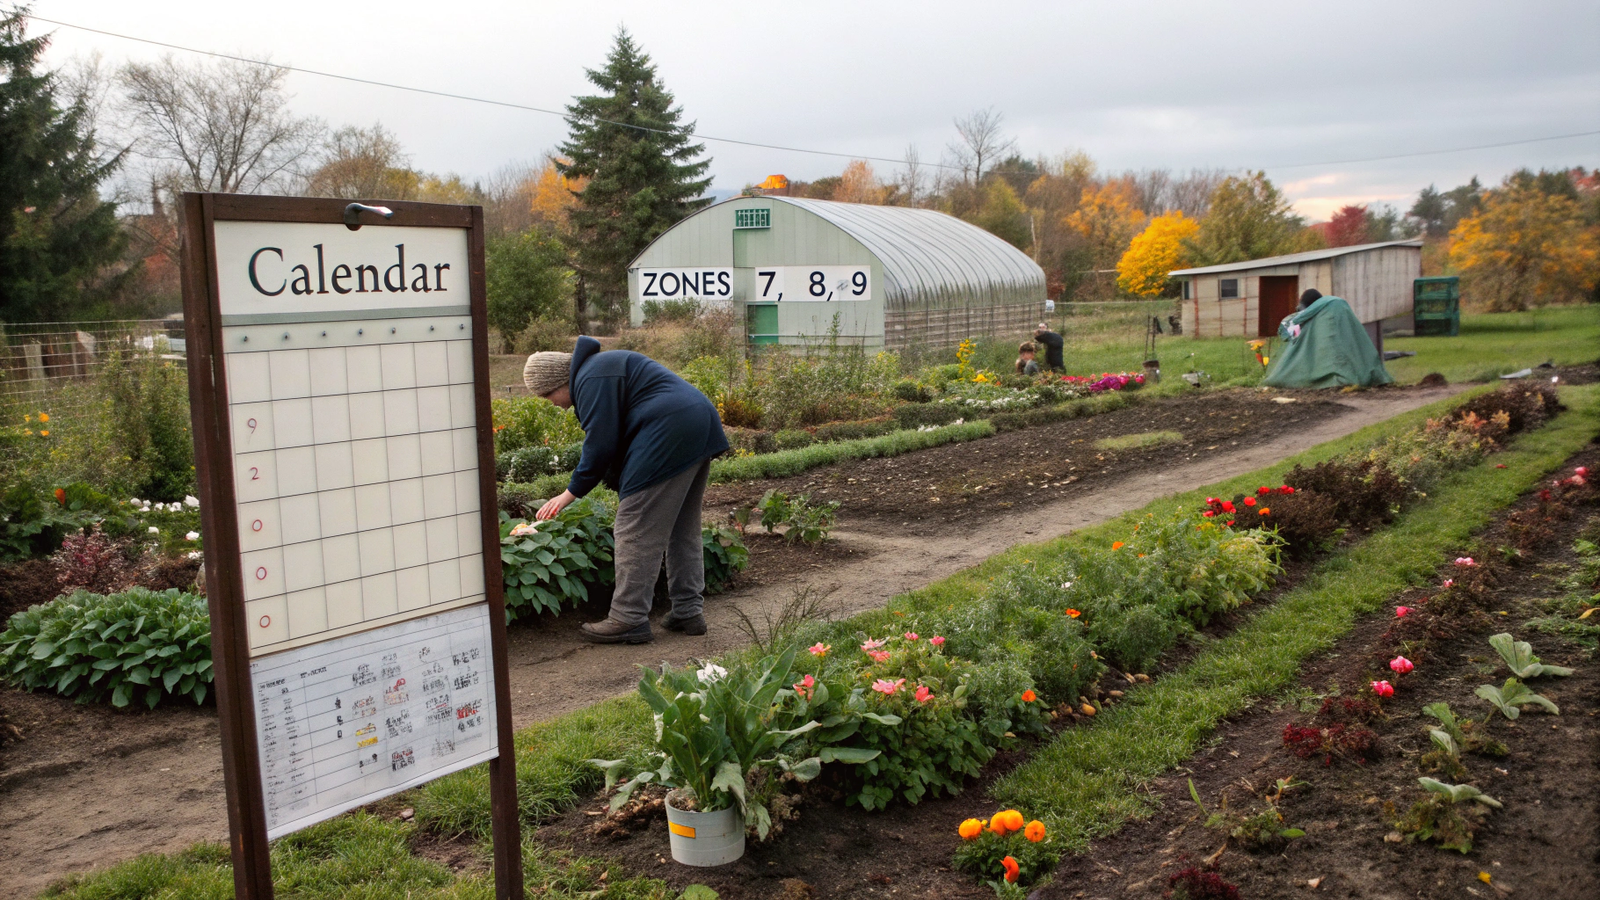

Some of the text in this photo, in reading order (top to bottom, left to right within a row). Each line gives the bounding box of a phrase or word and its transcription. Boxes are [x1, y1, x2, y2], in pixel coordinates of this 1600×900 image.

[248, 243, 450, 297] Calendar
[642, 271, 868, 302] ZONES 7, 8, 9
[249, 466, 260, 481] 2
